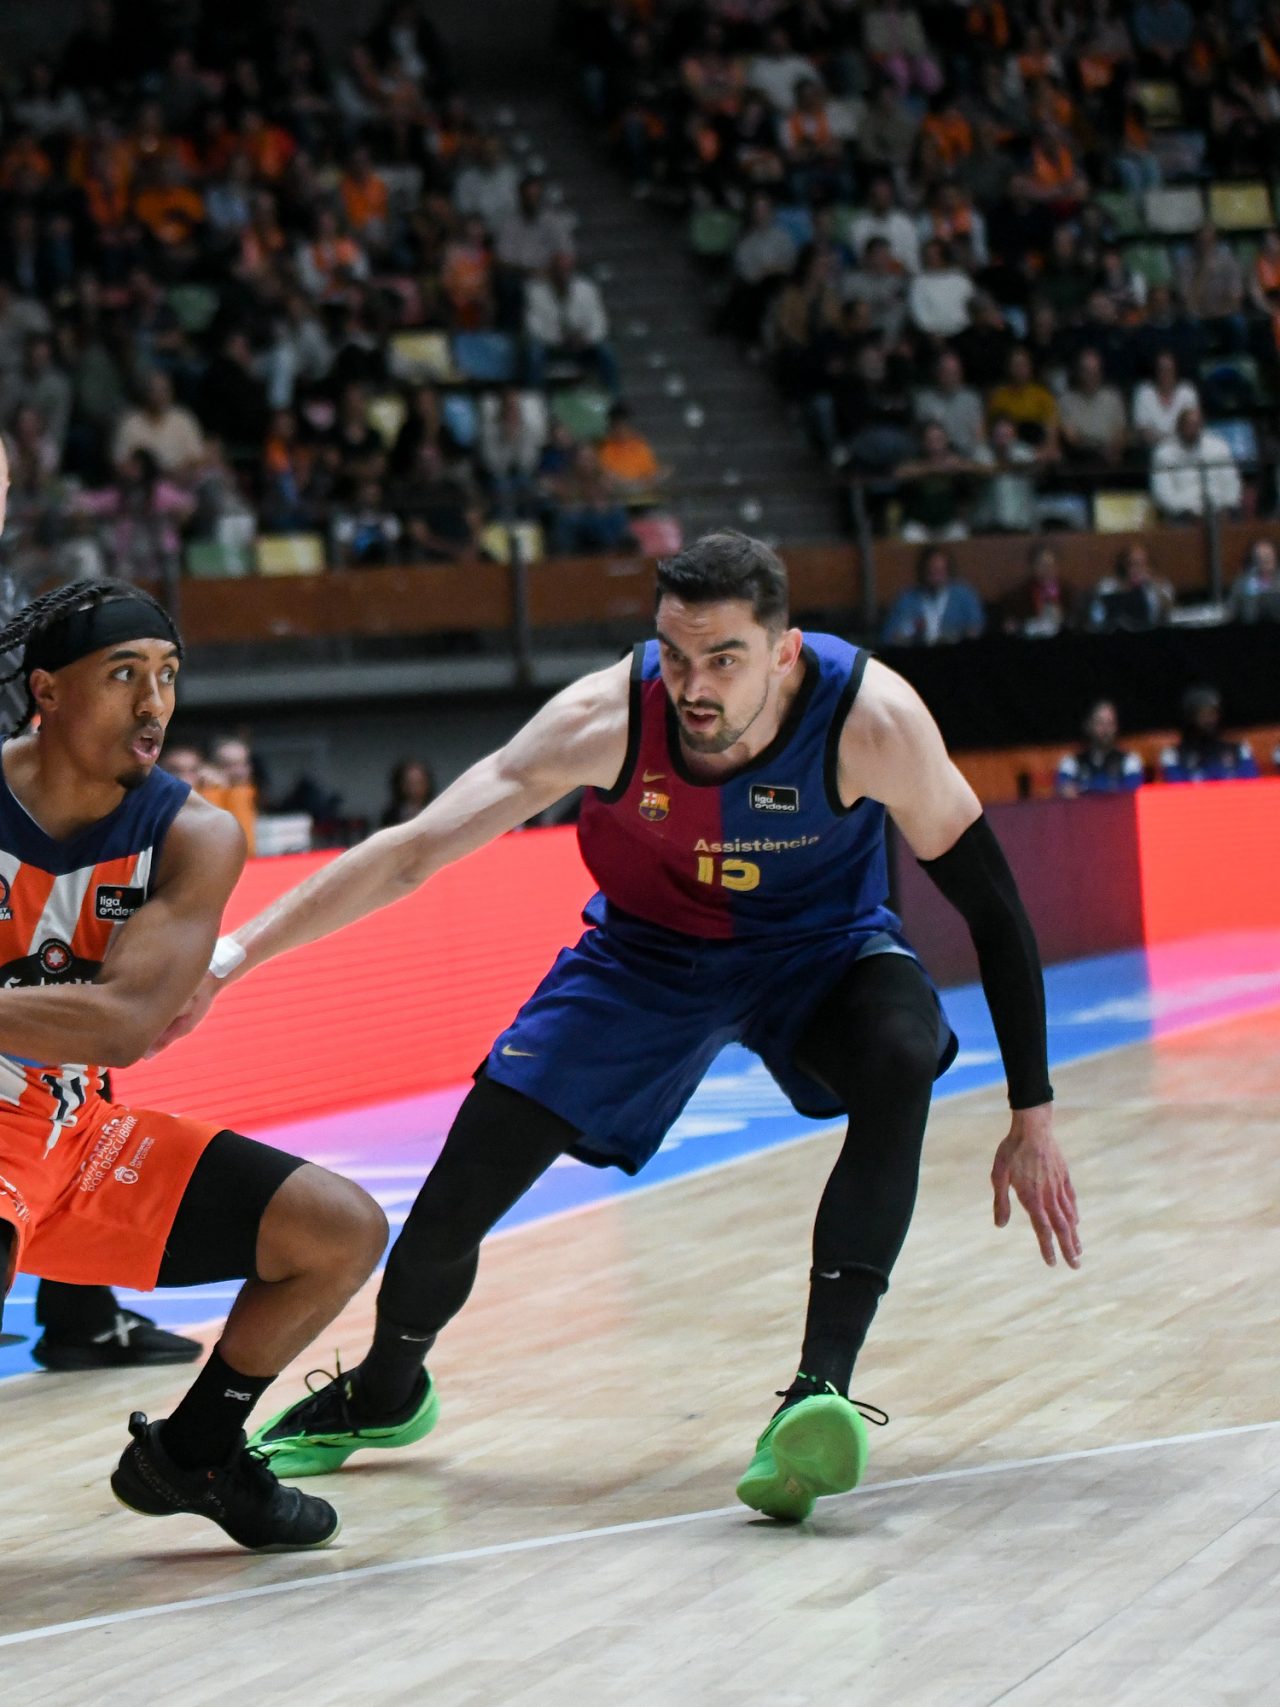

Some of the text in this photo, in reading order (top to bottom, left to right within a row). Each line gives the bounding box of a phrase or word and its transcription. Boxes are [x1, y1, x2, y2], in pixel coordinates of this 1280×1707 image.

[100, 895, 120, 907] liga
[88, 1171, 106, 1192] POR
[101, 1116, 138, 1169] DESCUBRIR
